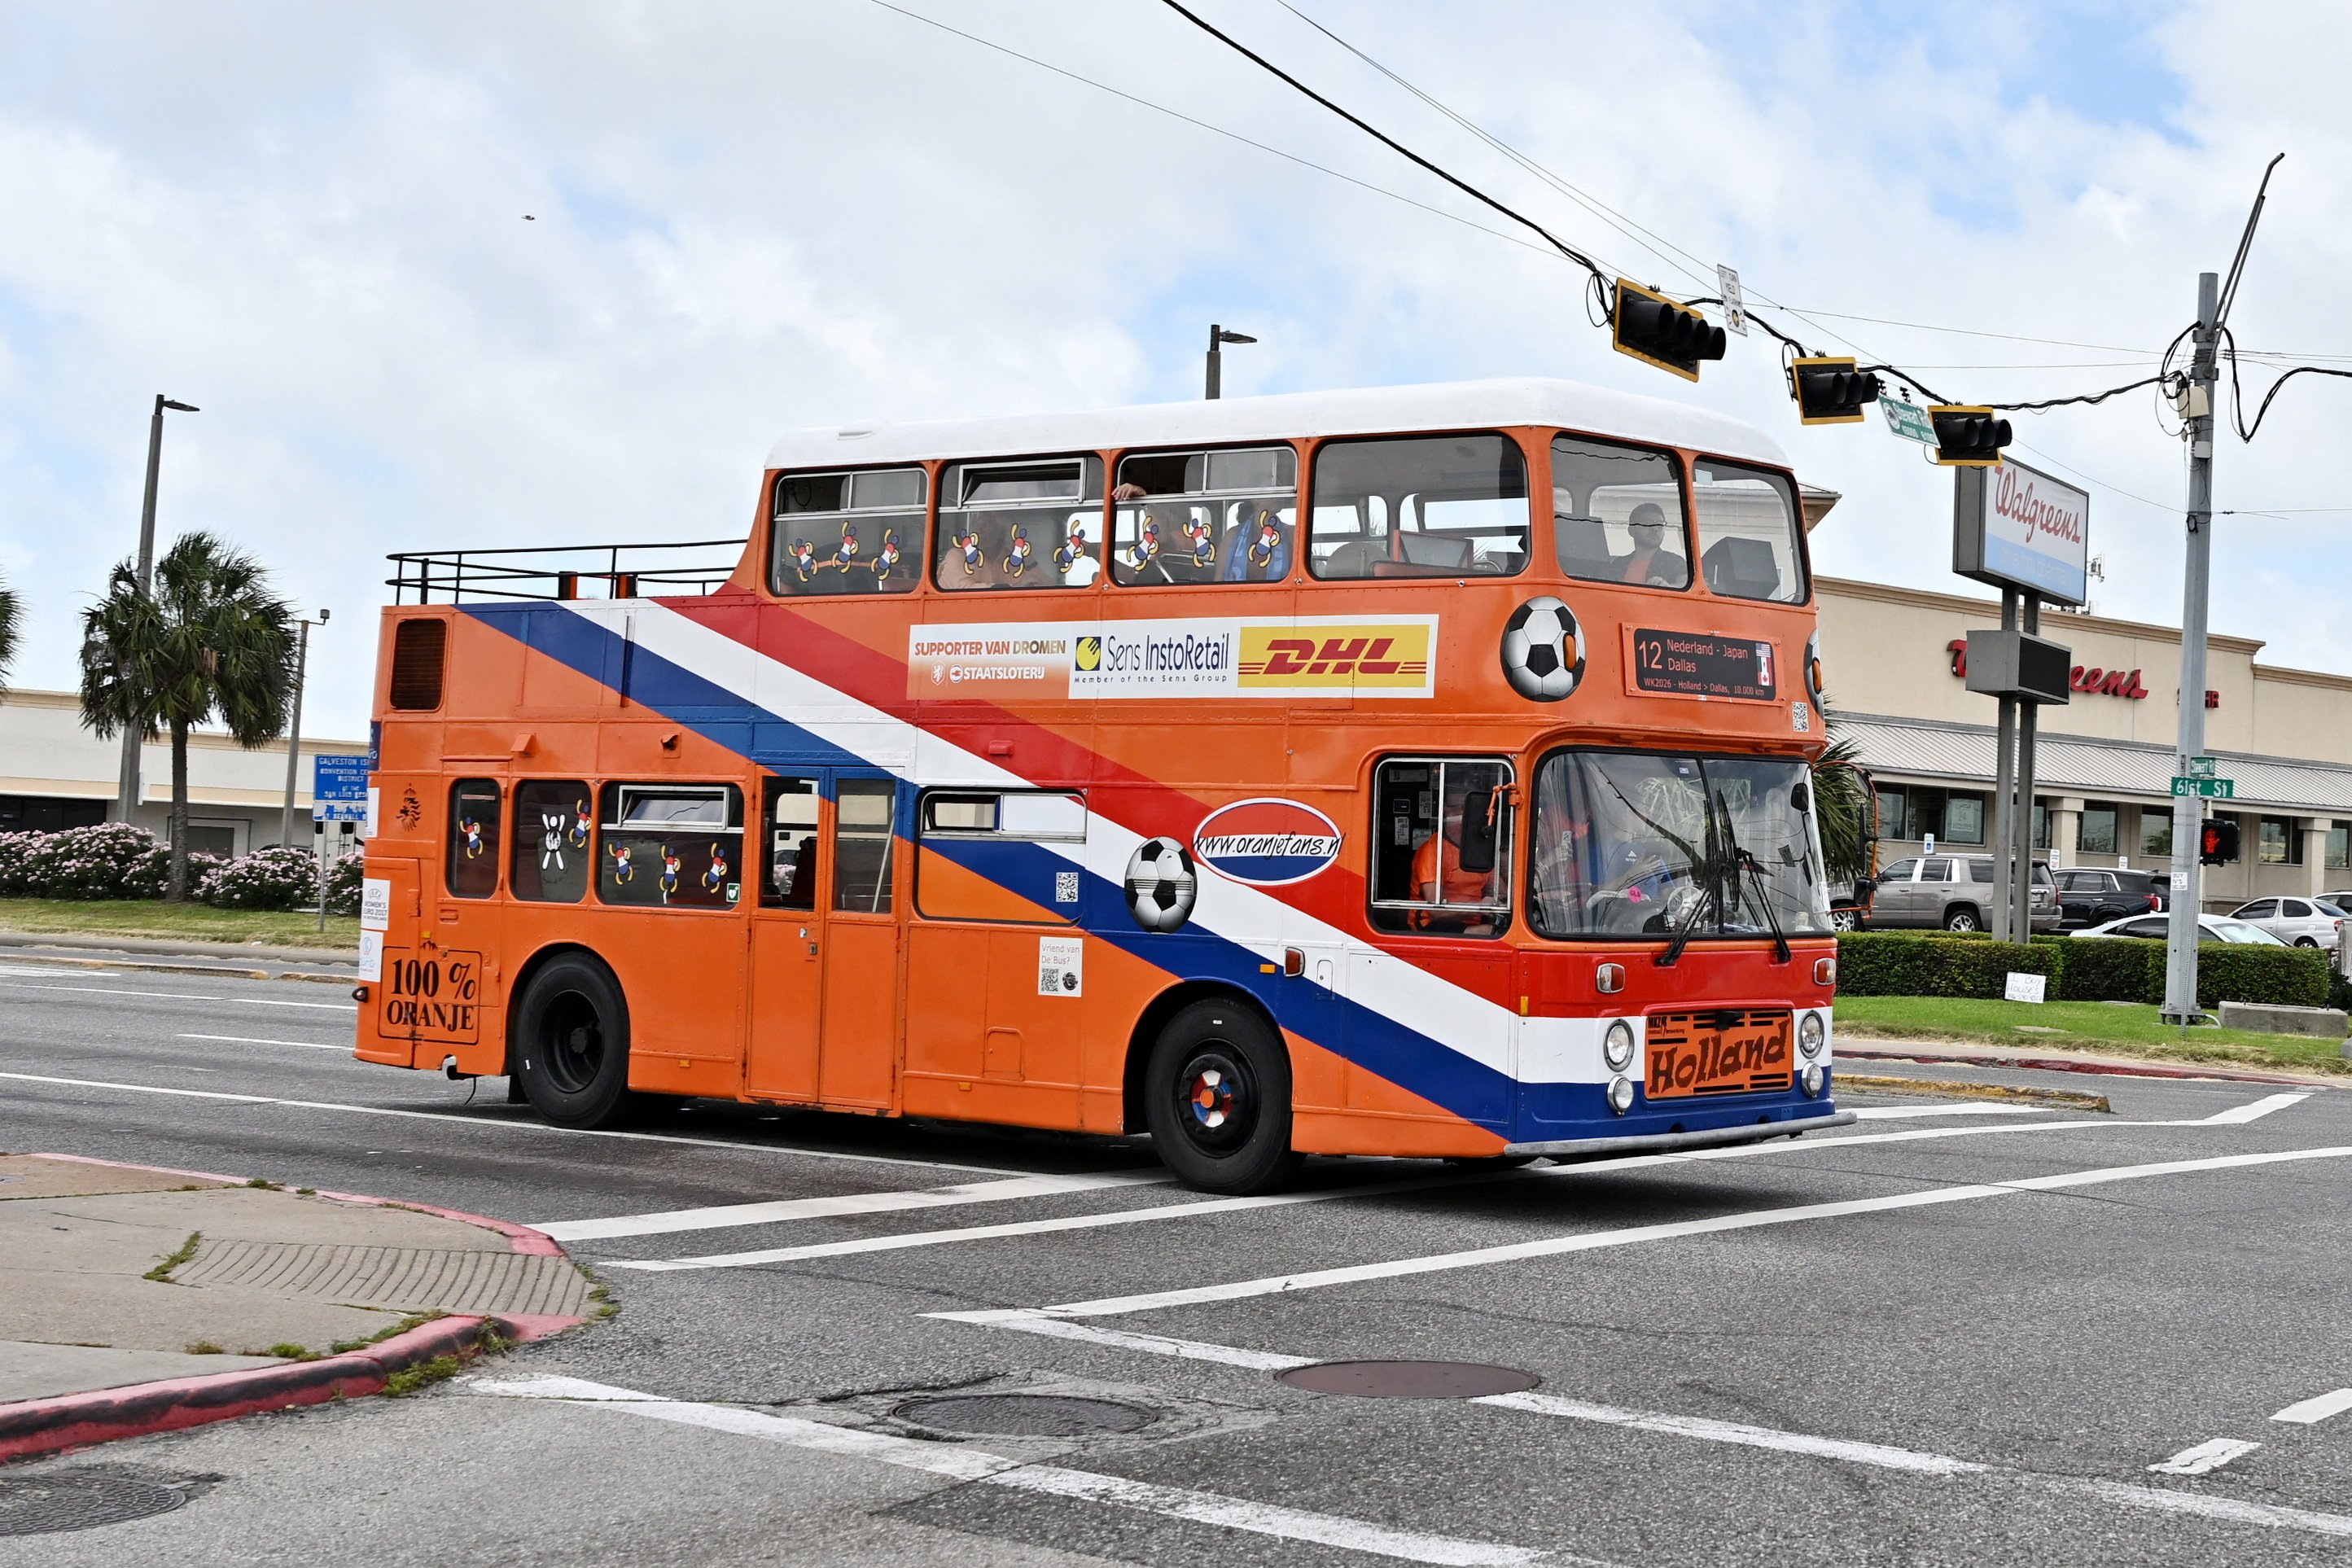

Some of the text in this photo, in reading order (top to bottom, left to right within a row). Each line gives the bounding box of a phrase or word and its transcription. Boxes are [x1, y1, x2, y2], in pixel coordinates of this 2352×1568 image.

[1995, 466, 2081, 544] Walgreens
[914, 640, 1067, 656] SUPPORTER VAN DROMEN
[1107, 633, 1230, 672] Sens InstoRetail
[1263, 637, 1401, 675] DHL
[1639, 640, 1662, 669] 12
[1667, 638, 1714, 655] Nederland
[1723, 644, 1748, 660] Japan
[963, 667, 1045, 681] STAATSLOTERIJ
[1668, 657, 1697, 672] Dallas
[1074, 674, 1228, 683] Member of the Sens Group
[1644, 677, 1671, 689] WK2026
[1678, 680, 1702, 690] Holland
[1710, 683, 1730, 694] Dallas,
[319, 757, 357, 765] GALVESTON
[2176, 779, 2227, 797] 61st St
[1192, 830, 1347, 861] www.oranjefans.nl
[1041, 944, 1065, 953] Vriend
[1041, 955, 1071, 965] De Bus?
[391, 958, 476, 1001] 100 %
[387, 1000, 475, 1032] ORANJE
[1649, 1018, 1790, 1095] Holland
